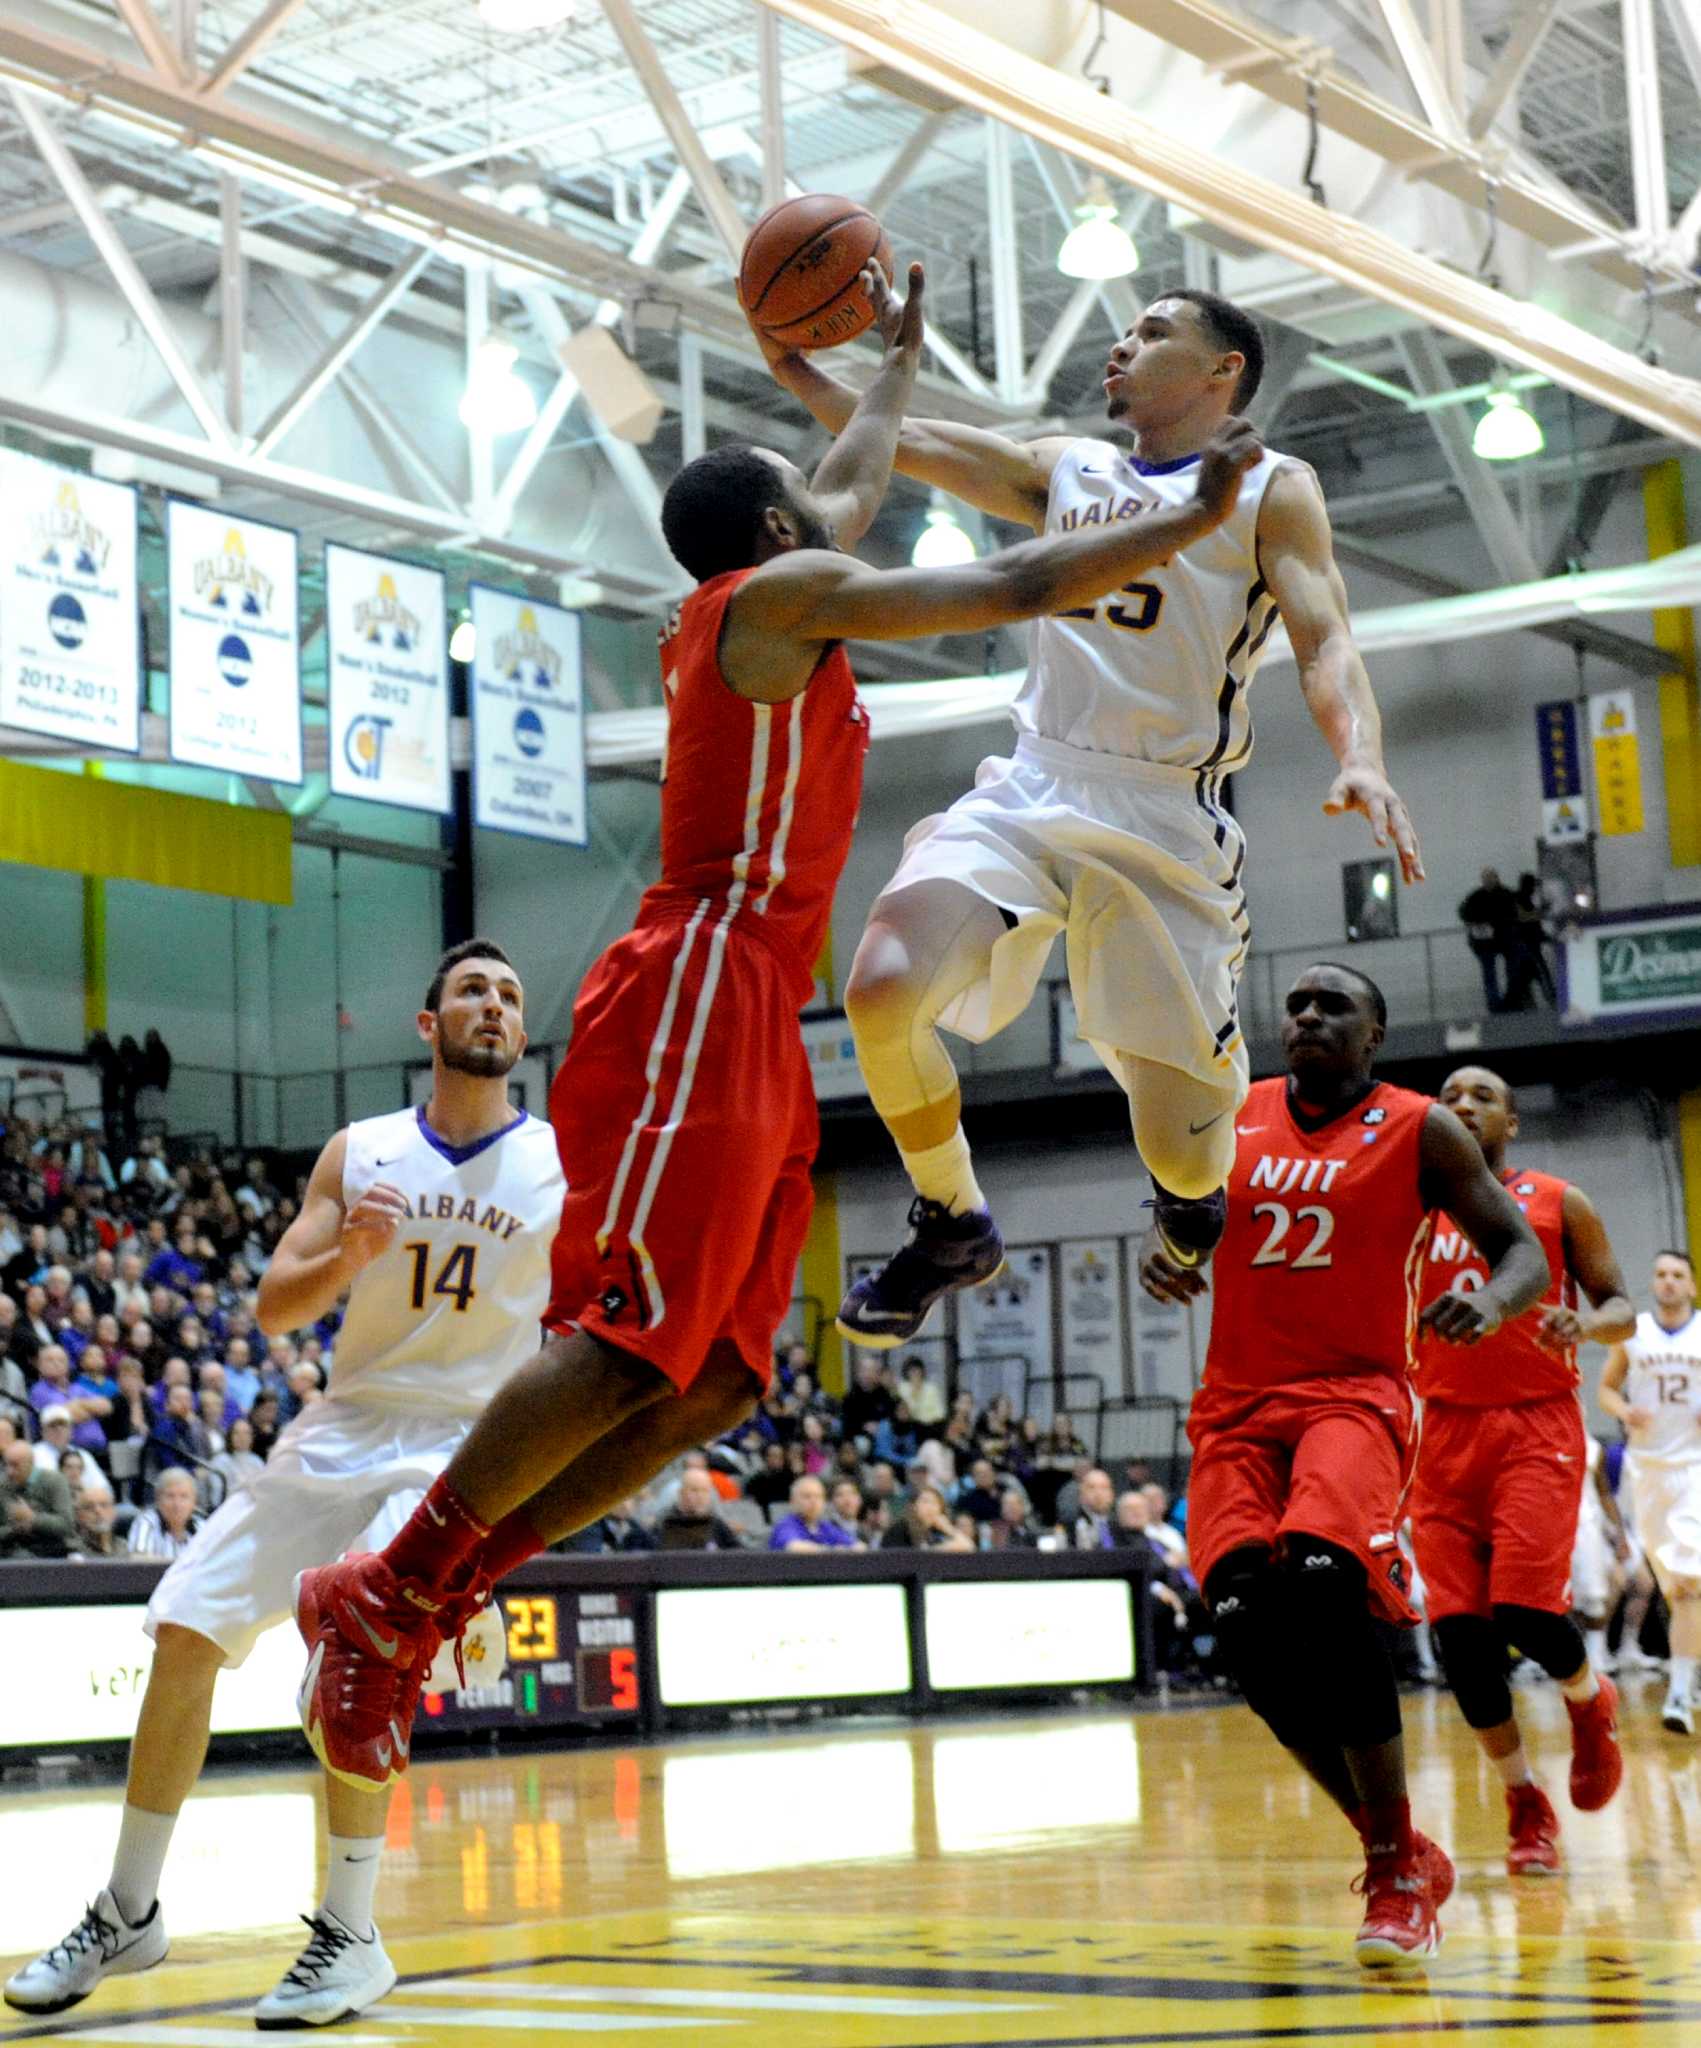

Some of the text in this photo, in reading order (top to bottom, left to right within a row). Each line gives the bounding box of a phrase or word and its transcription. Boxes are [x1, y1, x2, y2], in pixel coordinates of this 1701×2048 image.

[1249, 1154, 1347, 1195] NJIT
[1250, 1202, 1335, 1269] 22
[404, 1242, 479, 1312] 14
[1653, 1373, 1689, 1405] 12
[505, 1595, 558, 1661] 23
[610, 1647, 639, 1711] 5
